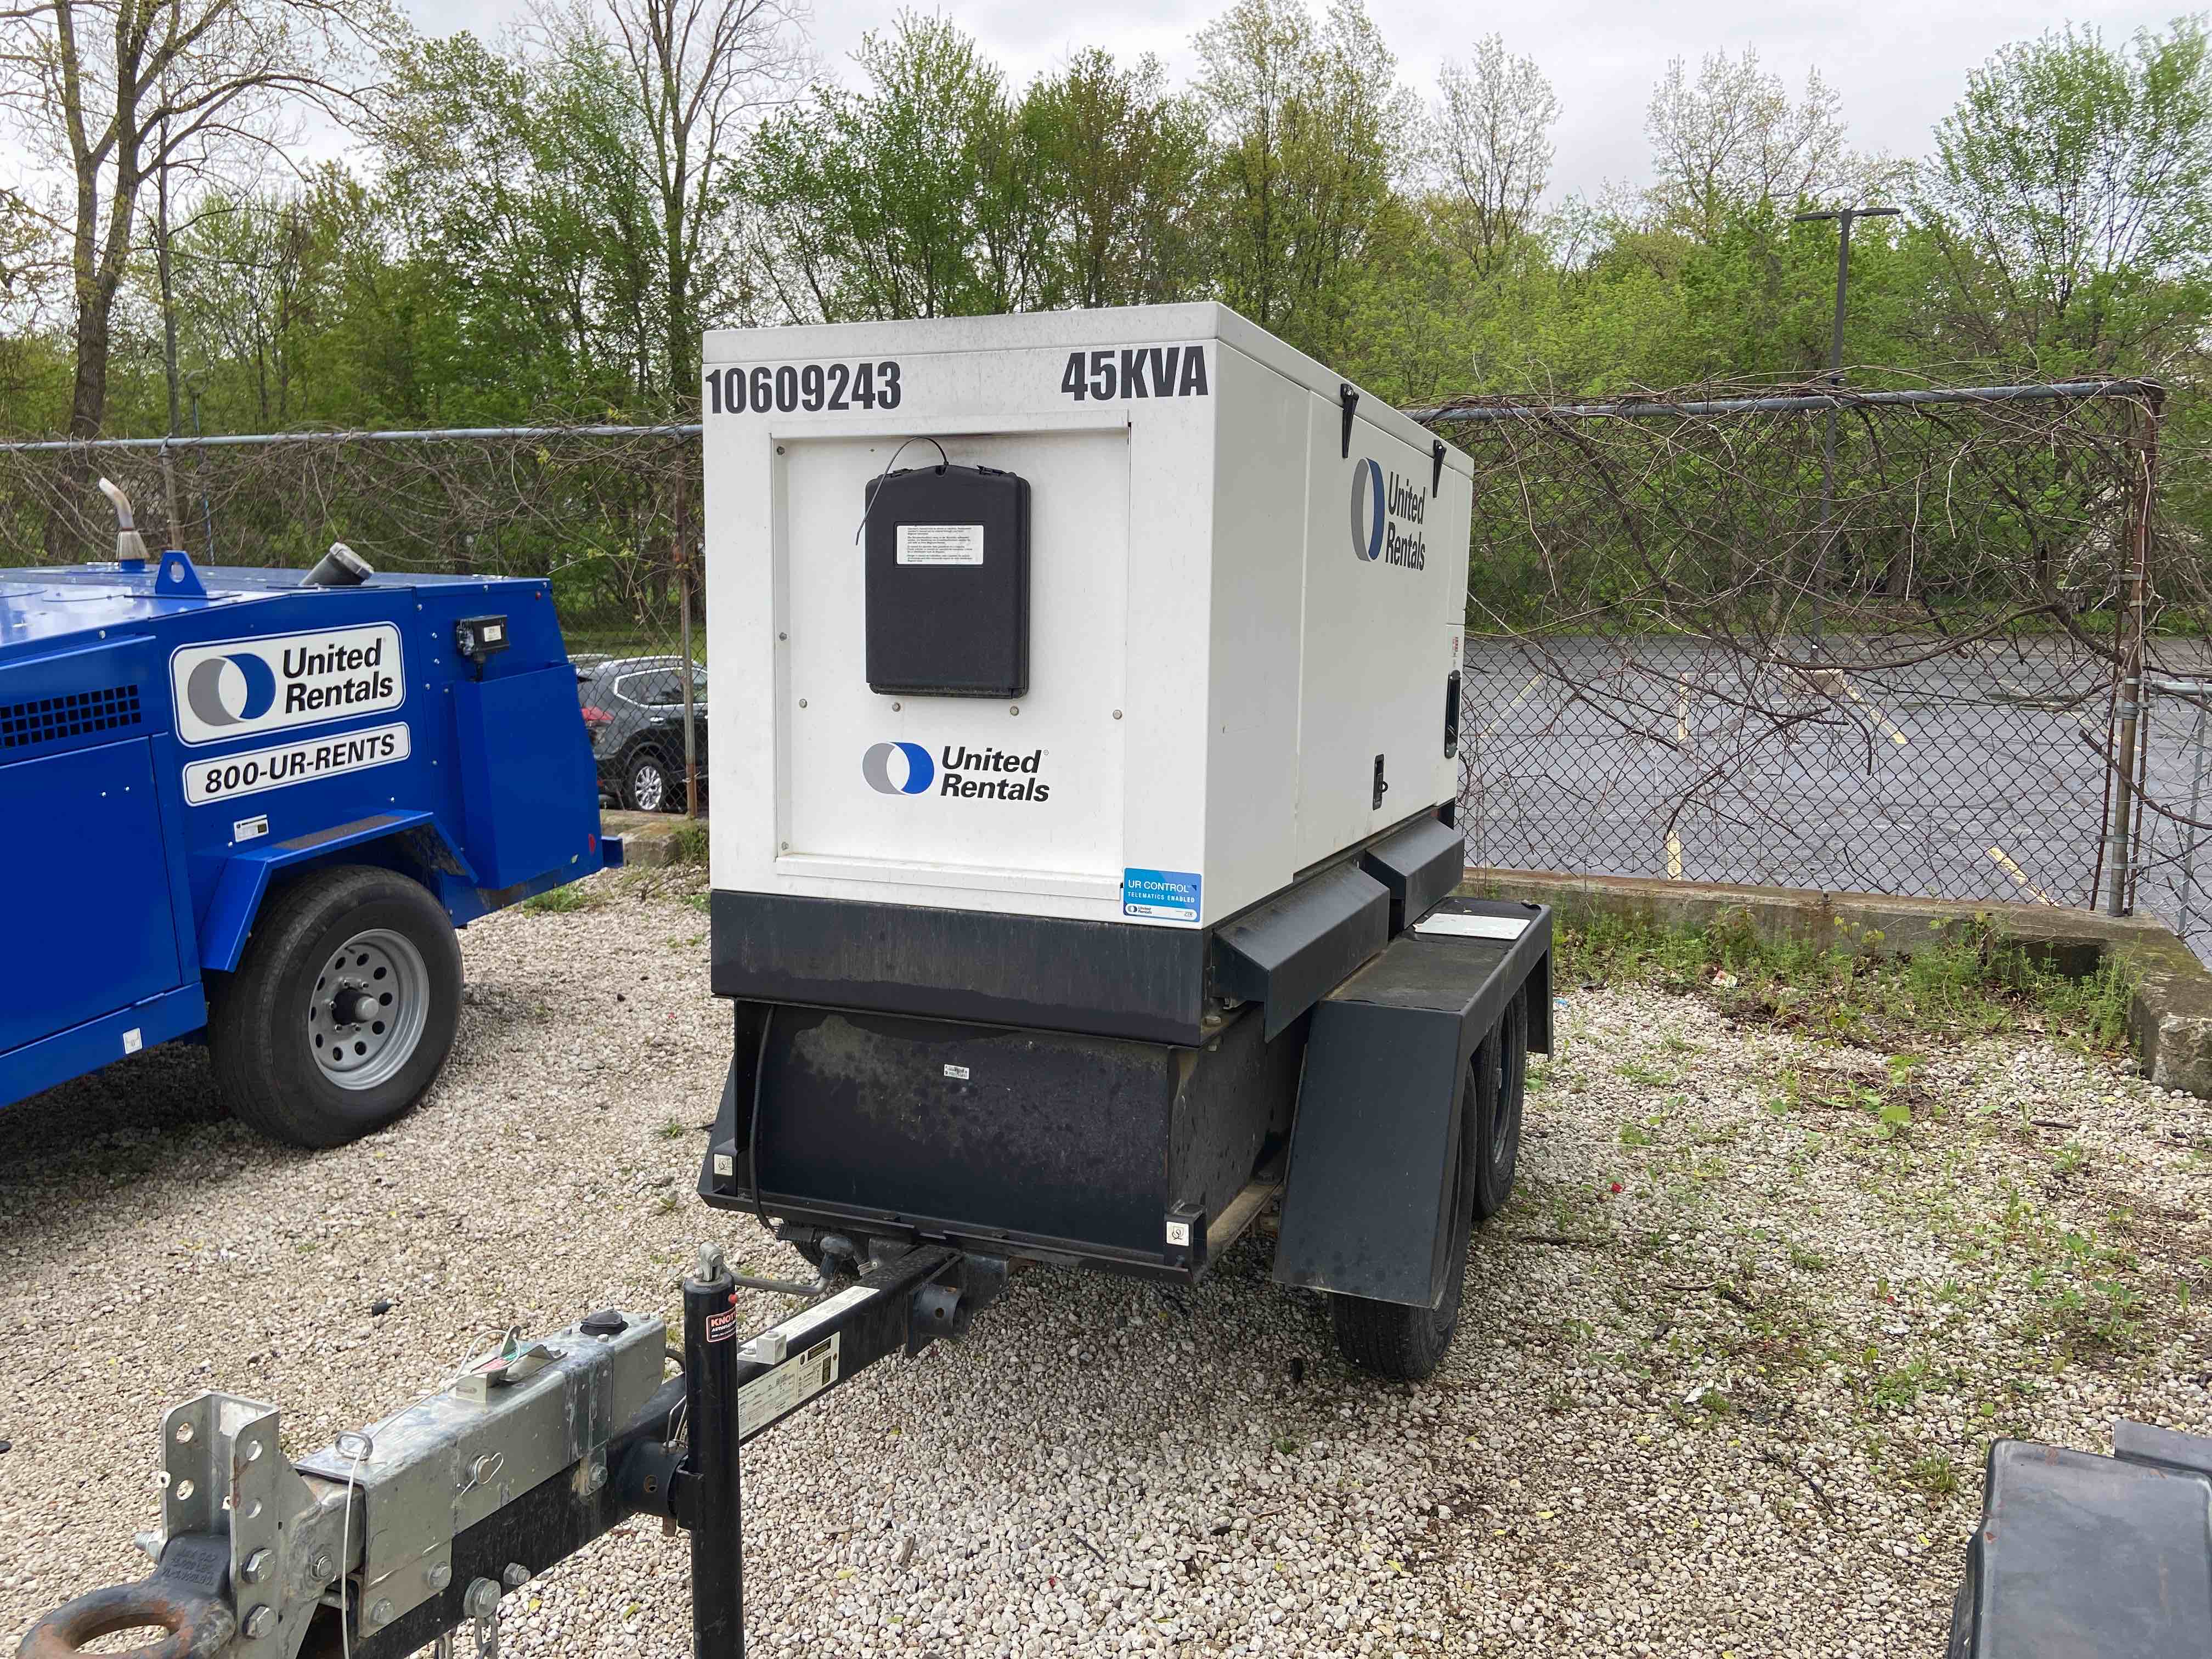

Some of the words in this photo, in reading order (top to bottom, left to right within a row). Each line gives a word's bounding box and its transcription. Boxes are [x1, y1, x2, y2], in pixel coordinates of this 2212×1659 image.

[705, 361, 901, 414] 10609243
[1061, 345, 1209, 401] 45KVA
[1388, 471, 1426, 524] United
[1385, 521, 1425, 571] Rentals
[283, 637, 382, 678] United
[285, 672, 393, 714] Rentals
[205, 733, 395, 793] 800-UR-RENTS
[941, 746, 1042, 773] United
[940, 772, 1050, 802] Rentals
[1127, 891, 1164, 900] TELEMATICS
[1167, 895, 1195, 903] ENABLED
[1128, 879, 1142, 888] UR
[1144, 881, 1189, 893] CONTROL
